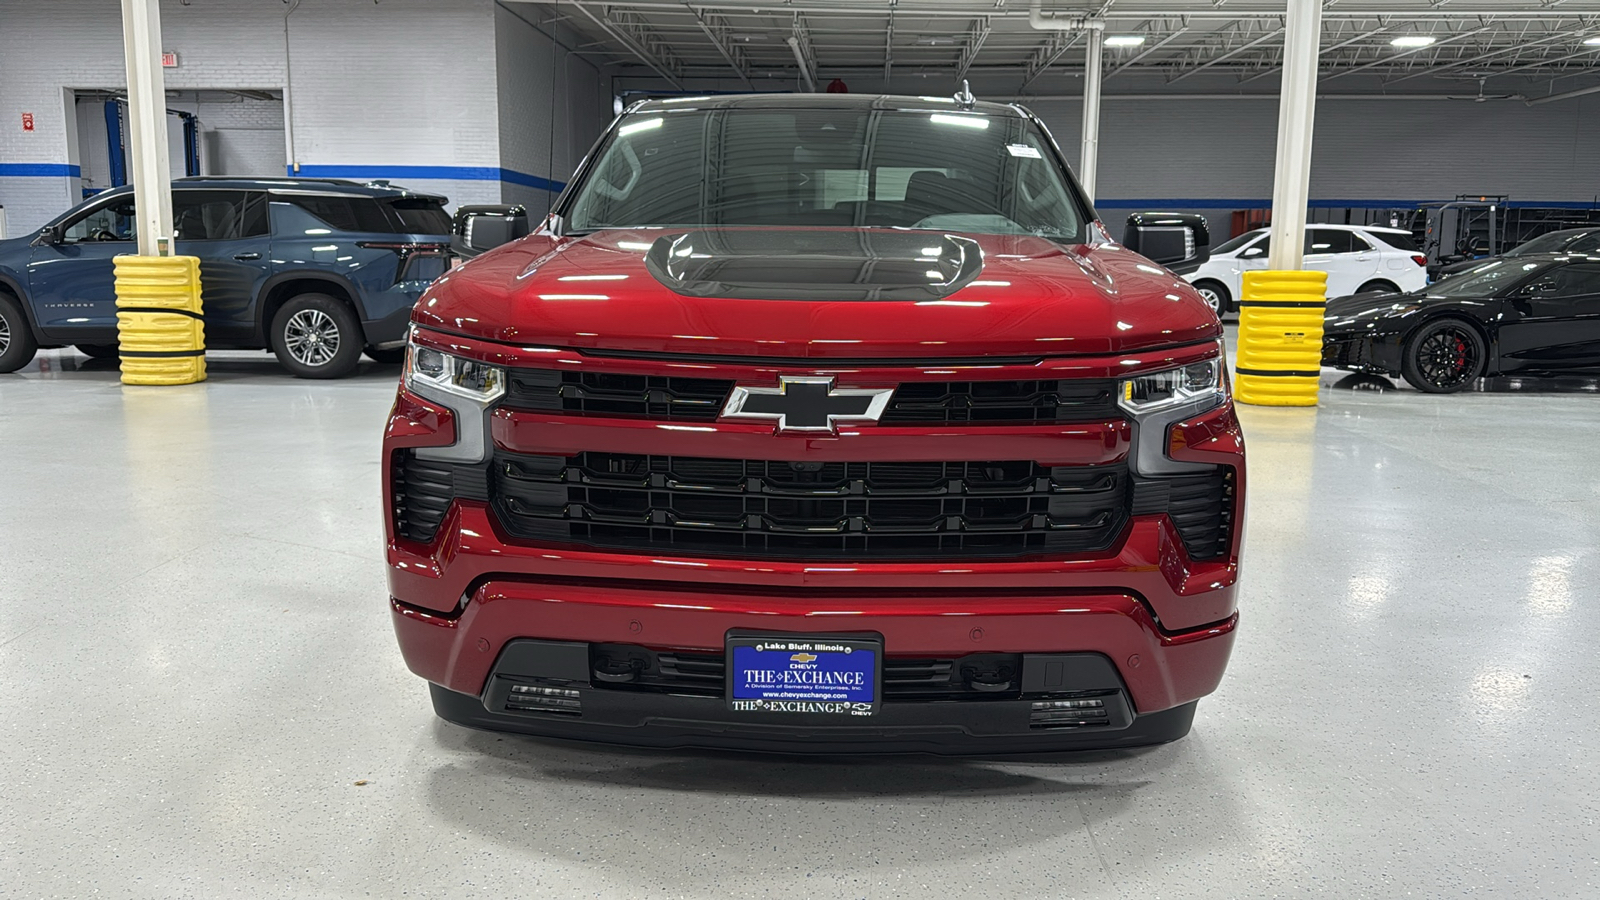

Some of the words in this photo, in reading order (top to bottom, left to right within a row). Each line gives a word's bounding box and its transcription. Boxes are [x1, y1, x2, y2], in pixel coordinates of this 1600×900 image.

[764, 642, 786, 650] Lake
[788, 643, 812, 651] Bluff,
[814, 643, 844, 651] Illinois
[743, 670, 776, 683] THE
[784, 670, 864, 685] EXCHANGE
[762, 691, 848, 700] www.chevyexchange.com
[732, 701, 758, 711] THE
[770, 701, 844, 713] EXCHANGE
